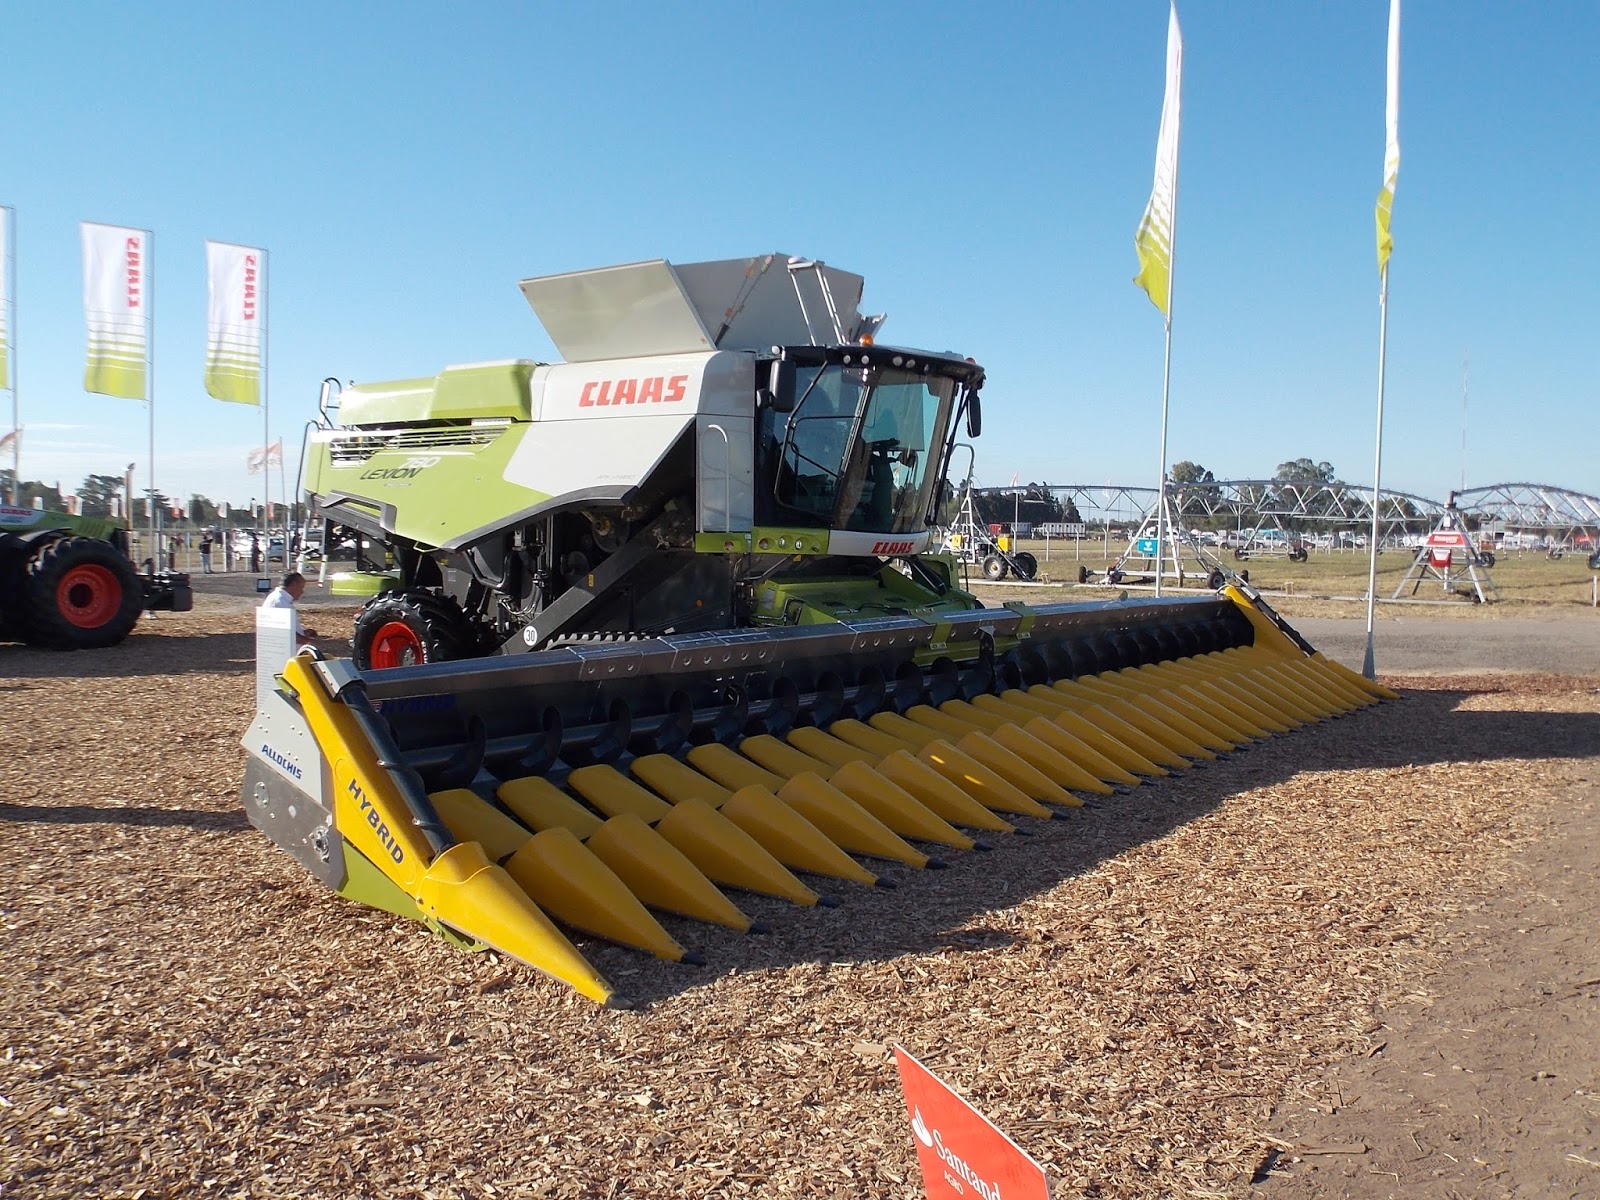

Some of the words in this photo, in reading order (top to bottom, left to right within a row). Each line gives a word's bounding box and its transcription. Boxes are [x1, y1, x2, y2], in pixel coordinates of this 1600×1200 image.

[578, 374, 689, 408] CLAAS
[360, 467, 424, 480] LEXION
[871, 541, 915, 554] CLAAS
[525, 629, 536, 642] 30
[261, 743, 303, 781] ALLOCHIS
[348, 778, 405, 865] HYBRID
[943, 1170, 965, 1196] AGRO
